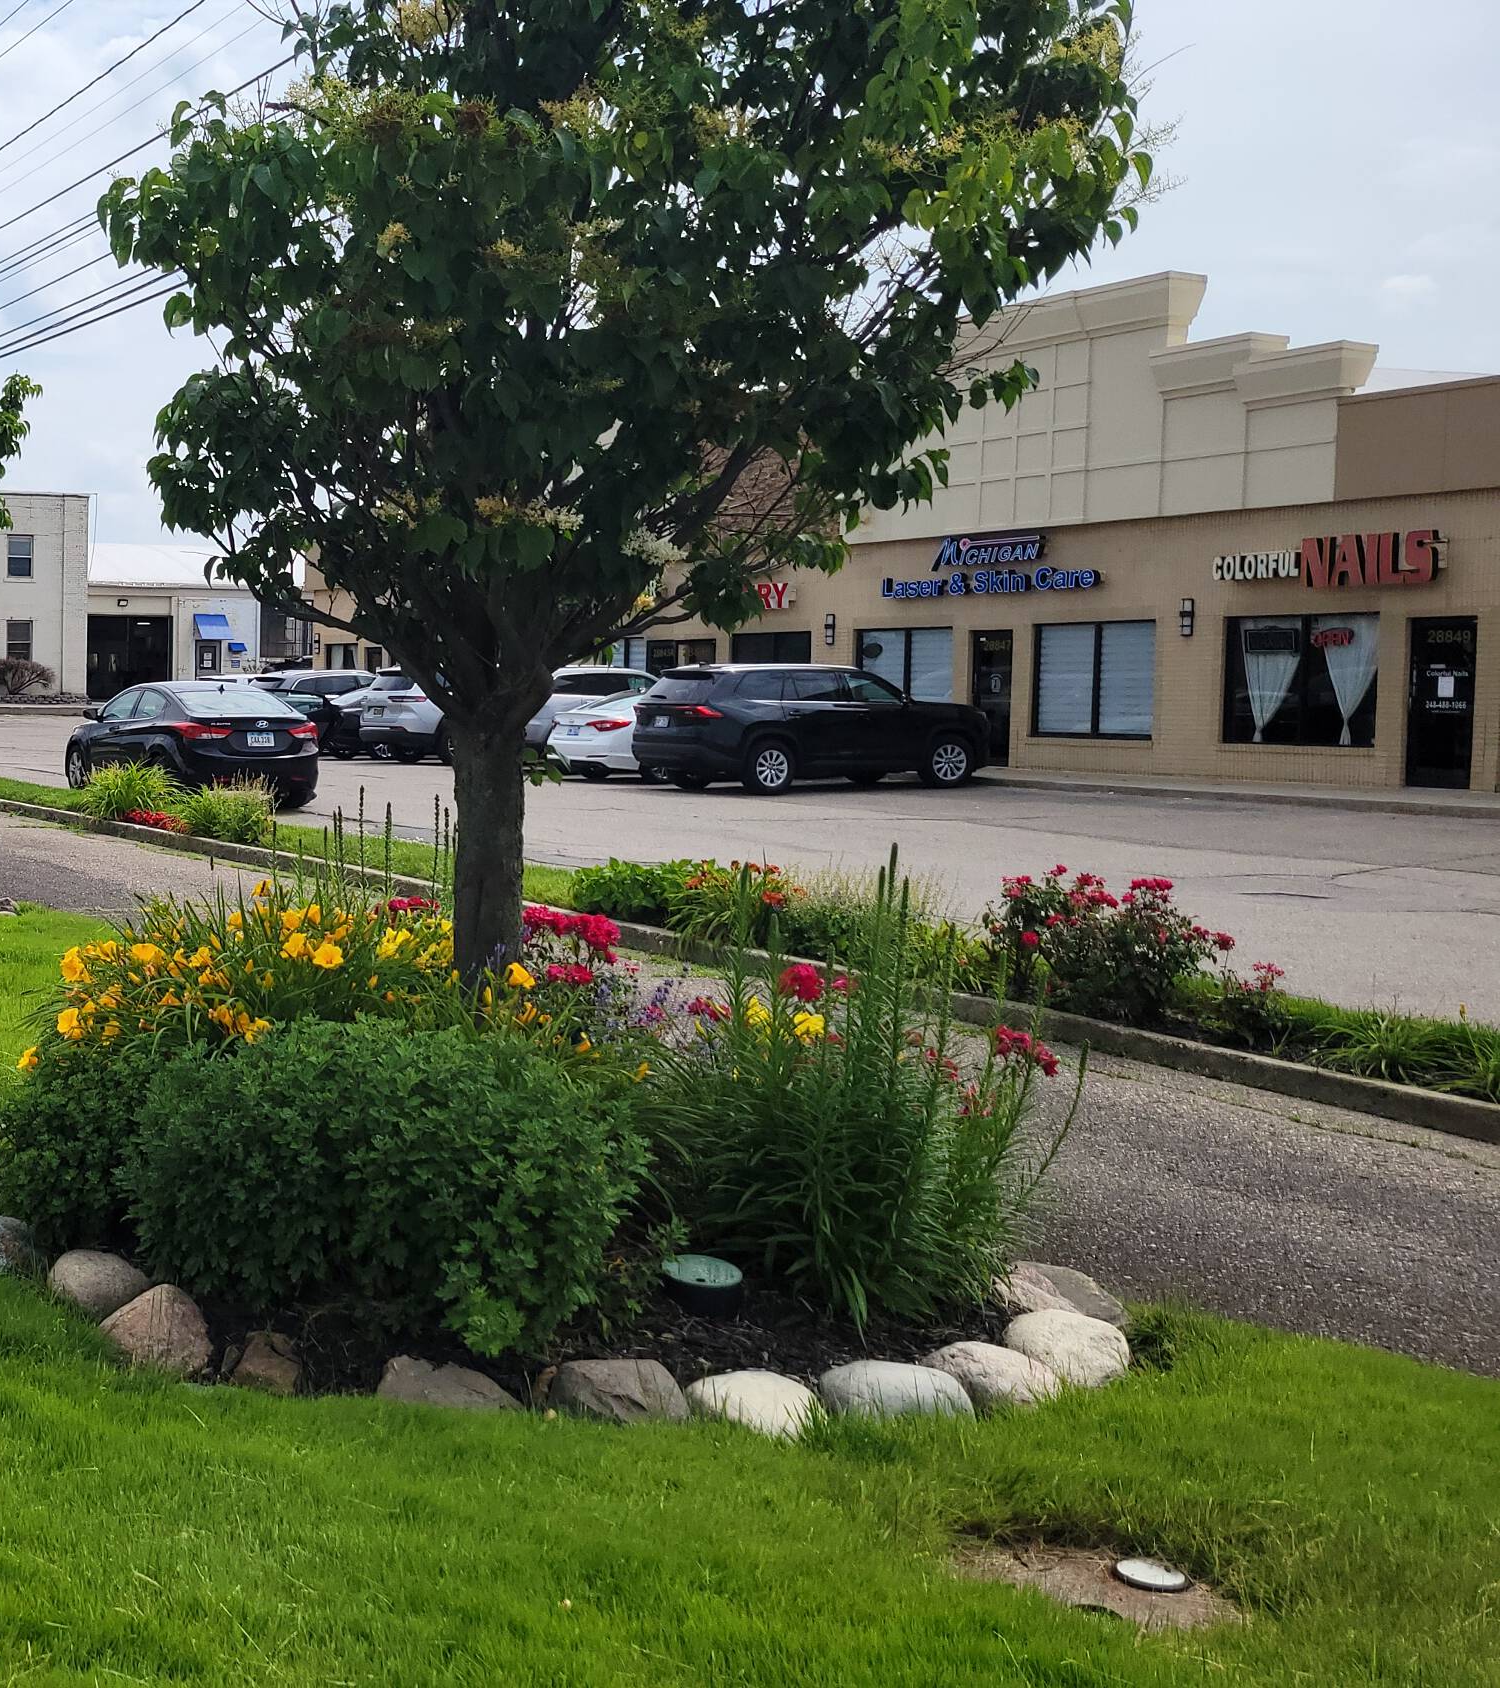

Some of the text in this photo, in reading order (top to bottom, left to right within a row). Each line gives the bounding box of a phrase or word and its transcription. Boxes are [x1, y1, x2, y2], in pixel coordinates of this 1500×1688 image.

[1212, 529, 1435, 589] COLORFUL NAILS
[754, 582, 789, 609] RY
[882, 565, 1095, 599] Laser & Skin Care
[1312, 631, 1349, 648] OPEN
[1427, 630, 1471, 644] 28849
